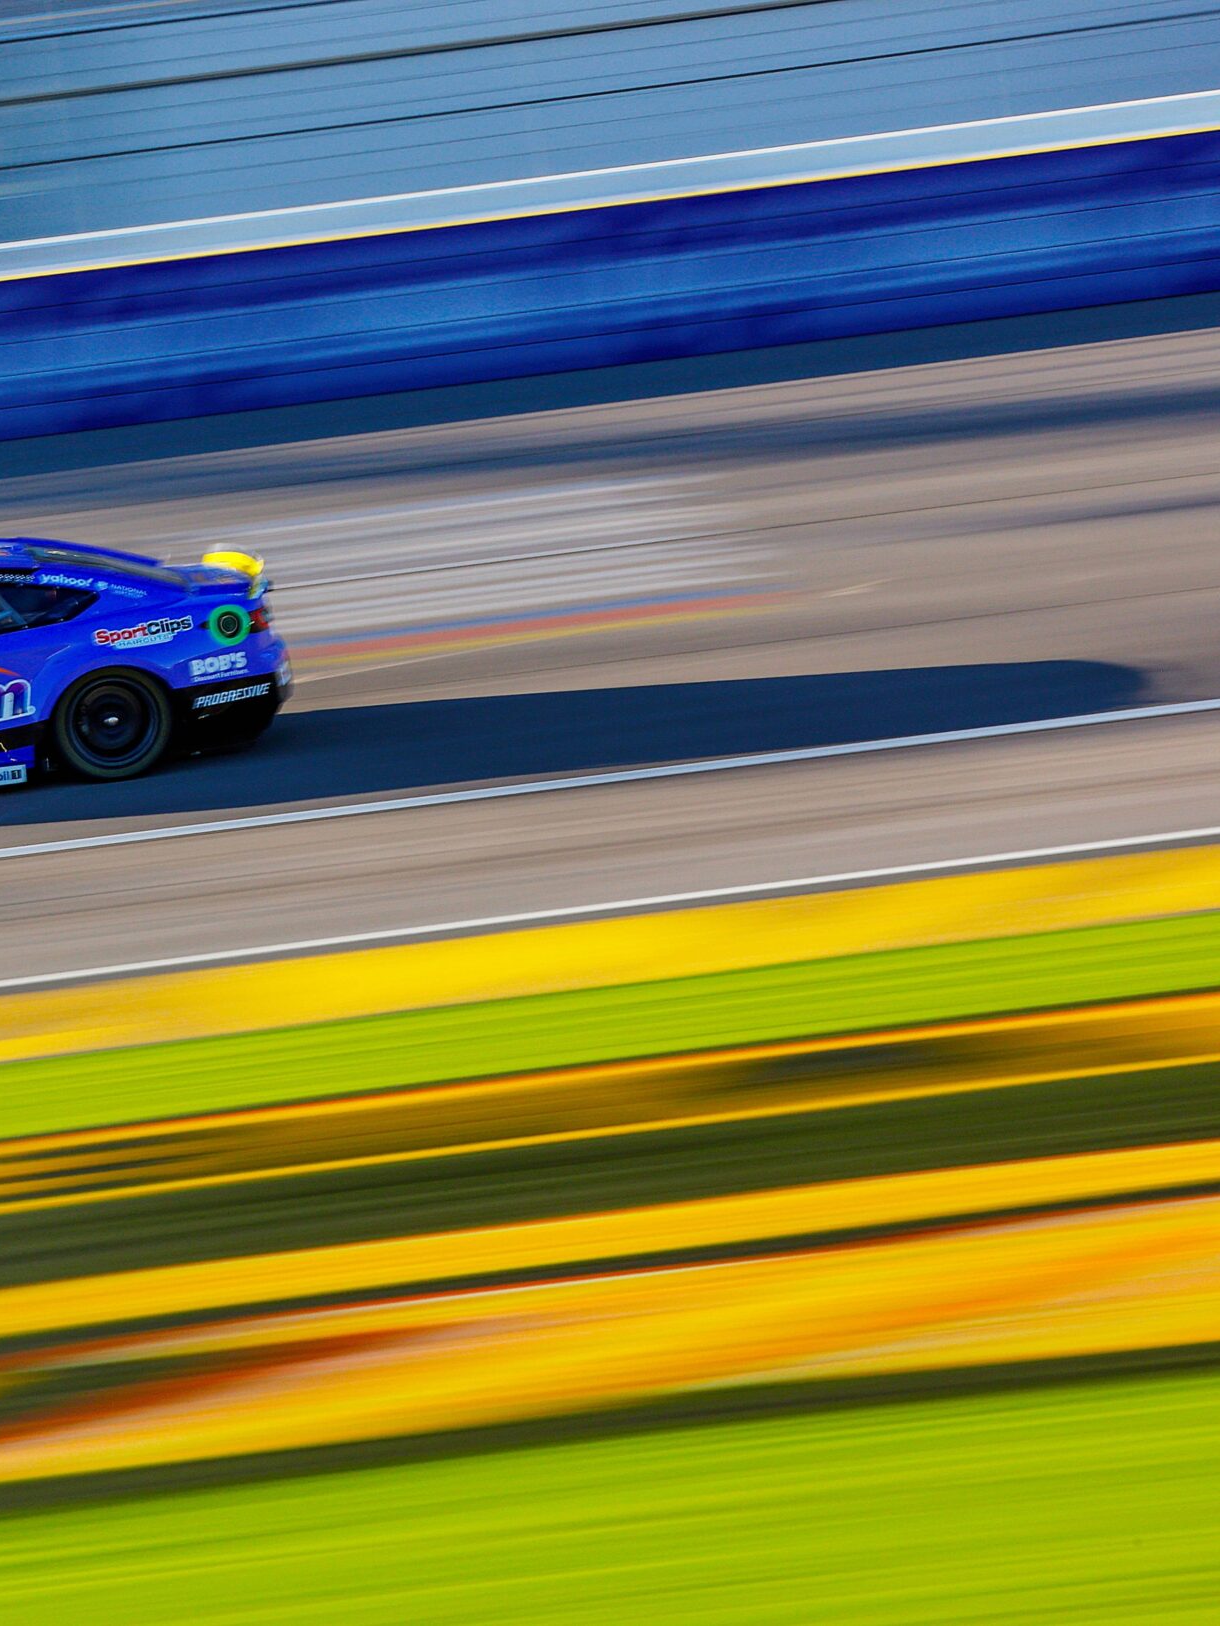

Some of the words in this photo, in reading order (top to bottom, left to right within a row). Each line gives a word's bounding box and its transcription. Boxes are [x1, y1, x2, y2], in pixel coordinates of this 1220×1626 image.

[39, 574, 94, 587] yahoo!
[190, 651, 248, 676] BOB'S
[193, 682, 271, 709] PROGRESSIVE
